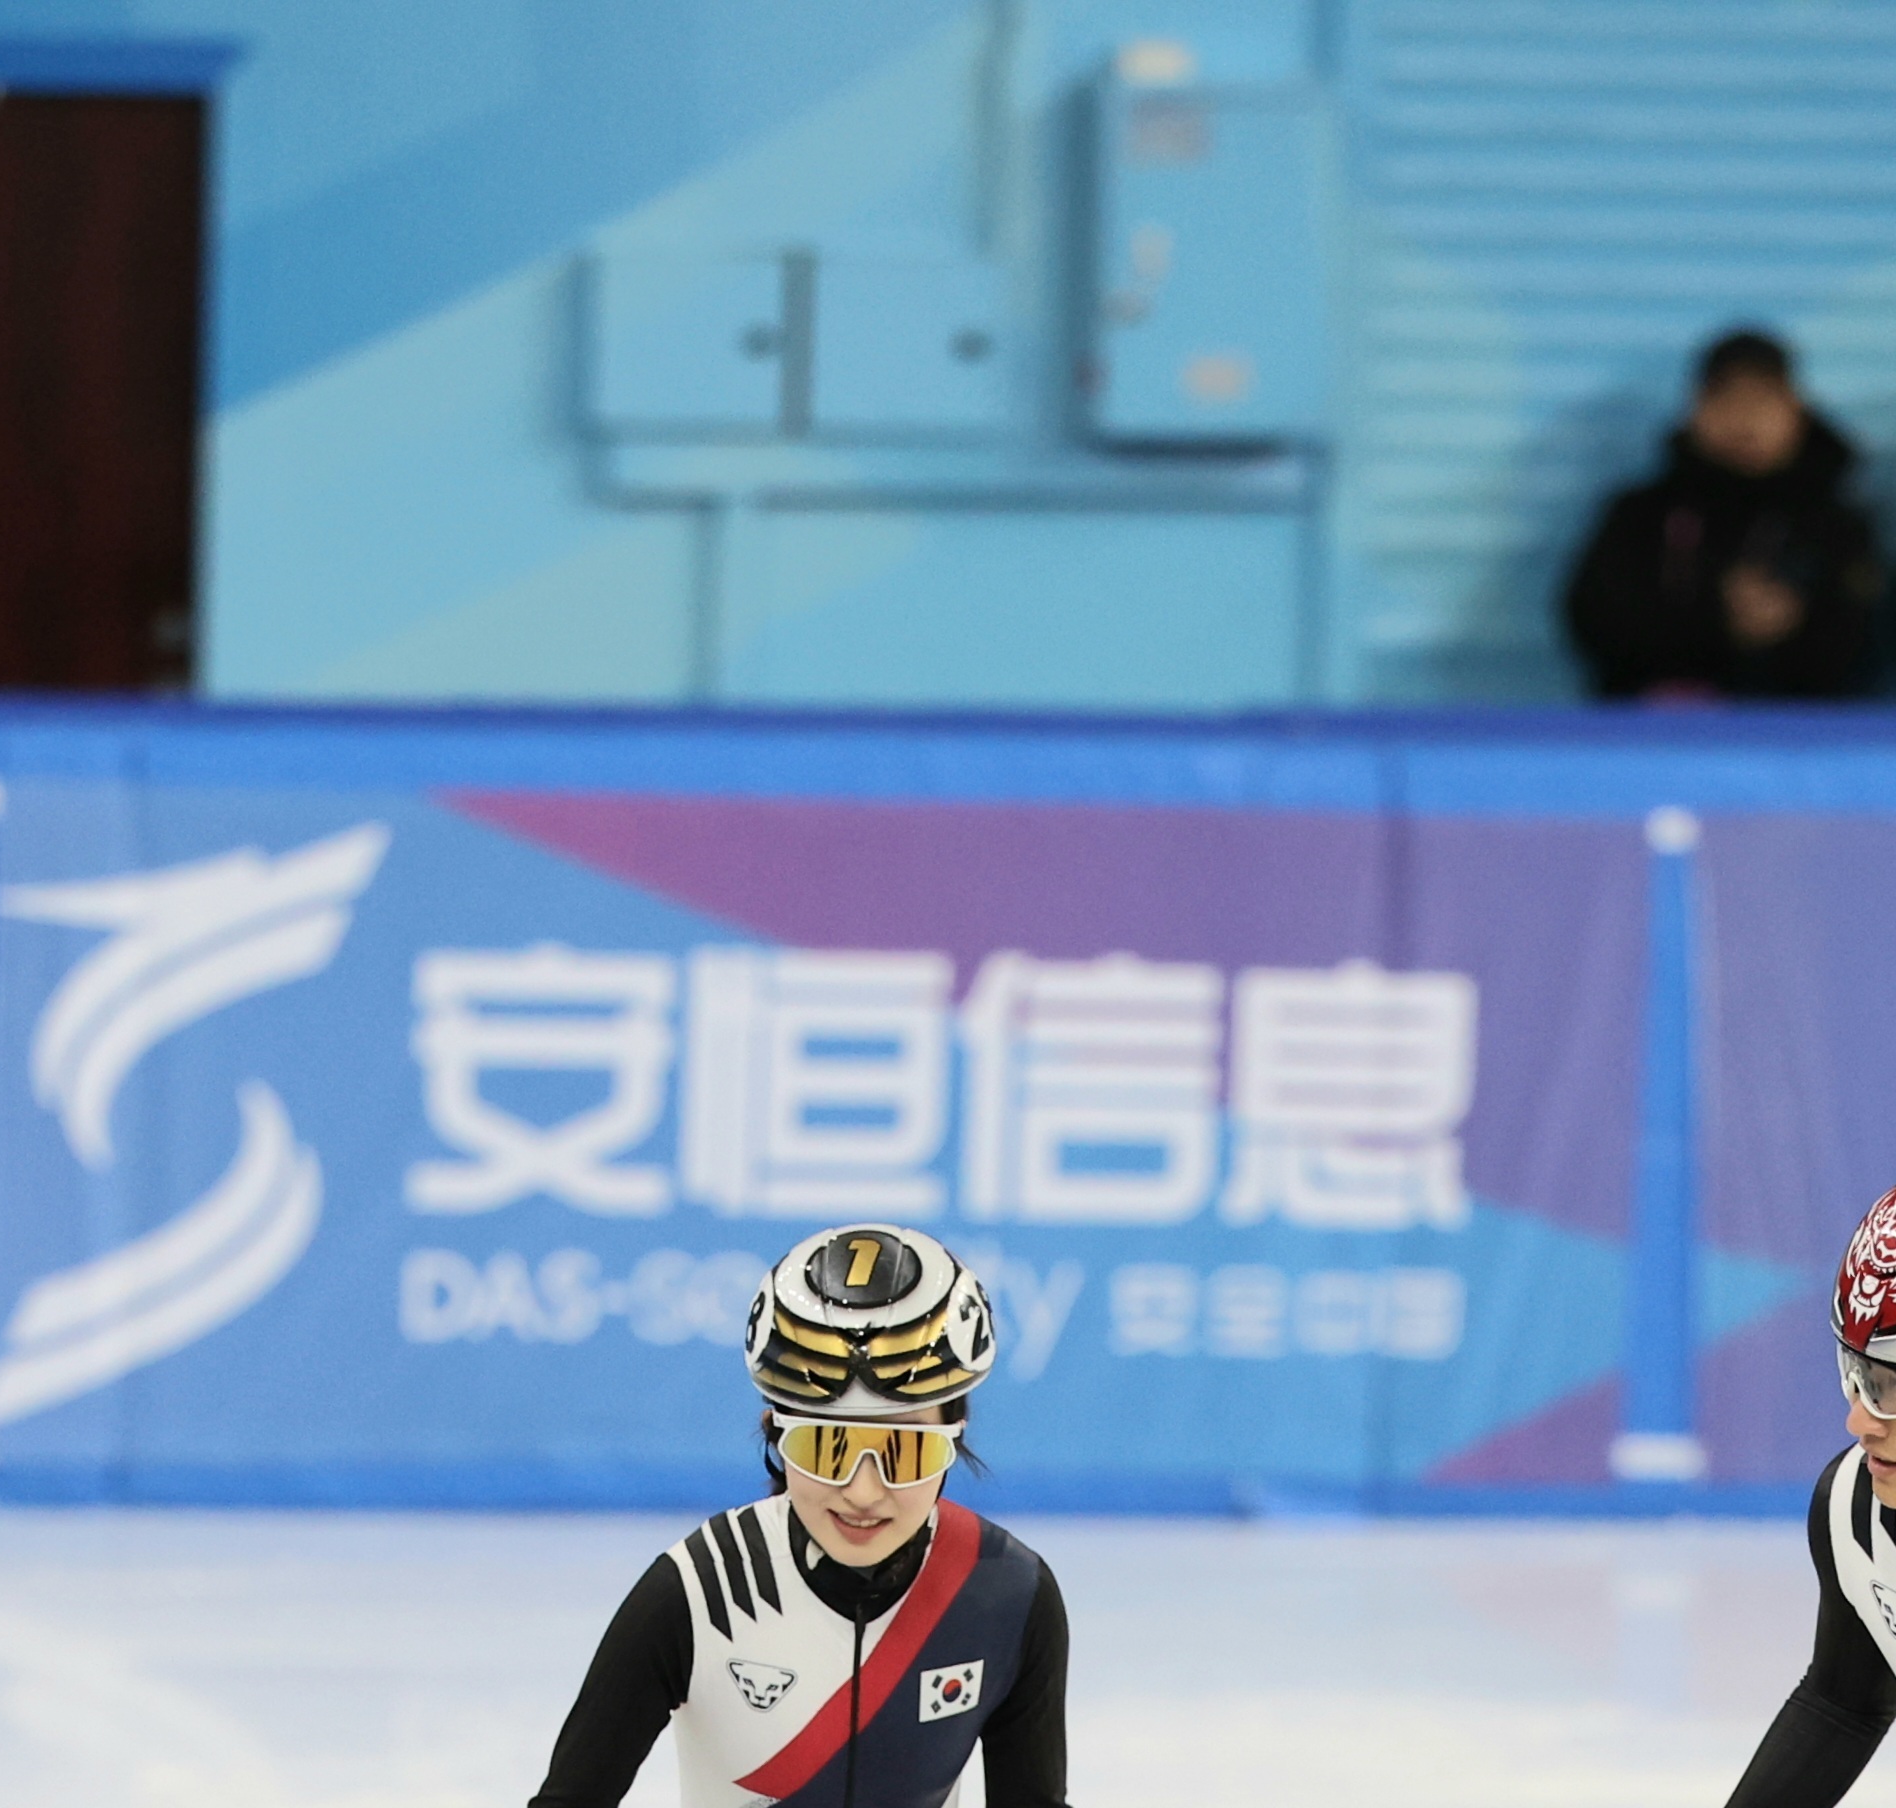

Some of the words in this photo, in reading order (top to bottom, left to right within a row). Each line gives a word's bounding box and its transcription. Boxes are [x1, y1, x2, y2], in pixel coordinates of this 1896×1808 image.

[402, 943, 1480, 1229] 安恒信息
[846, 1238, 881, 1287] 1
